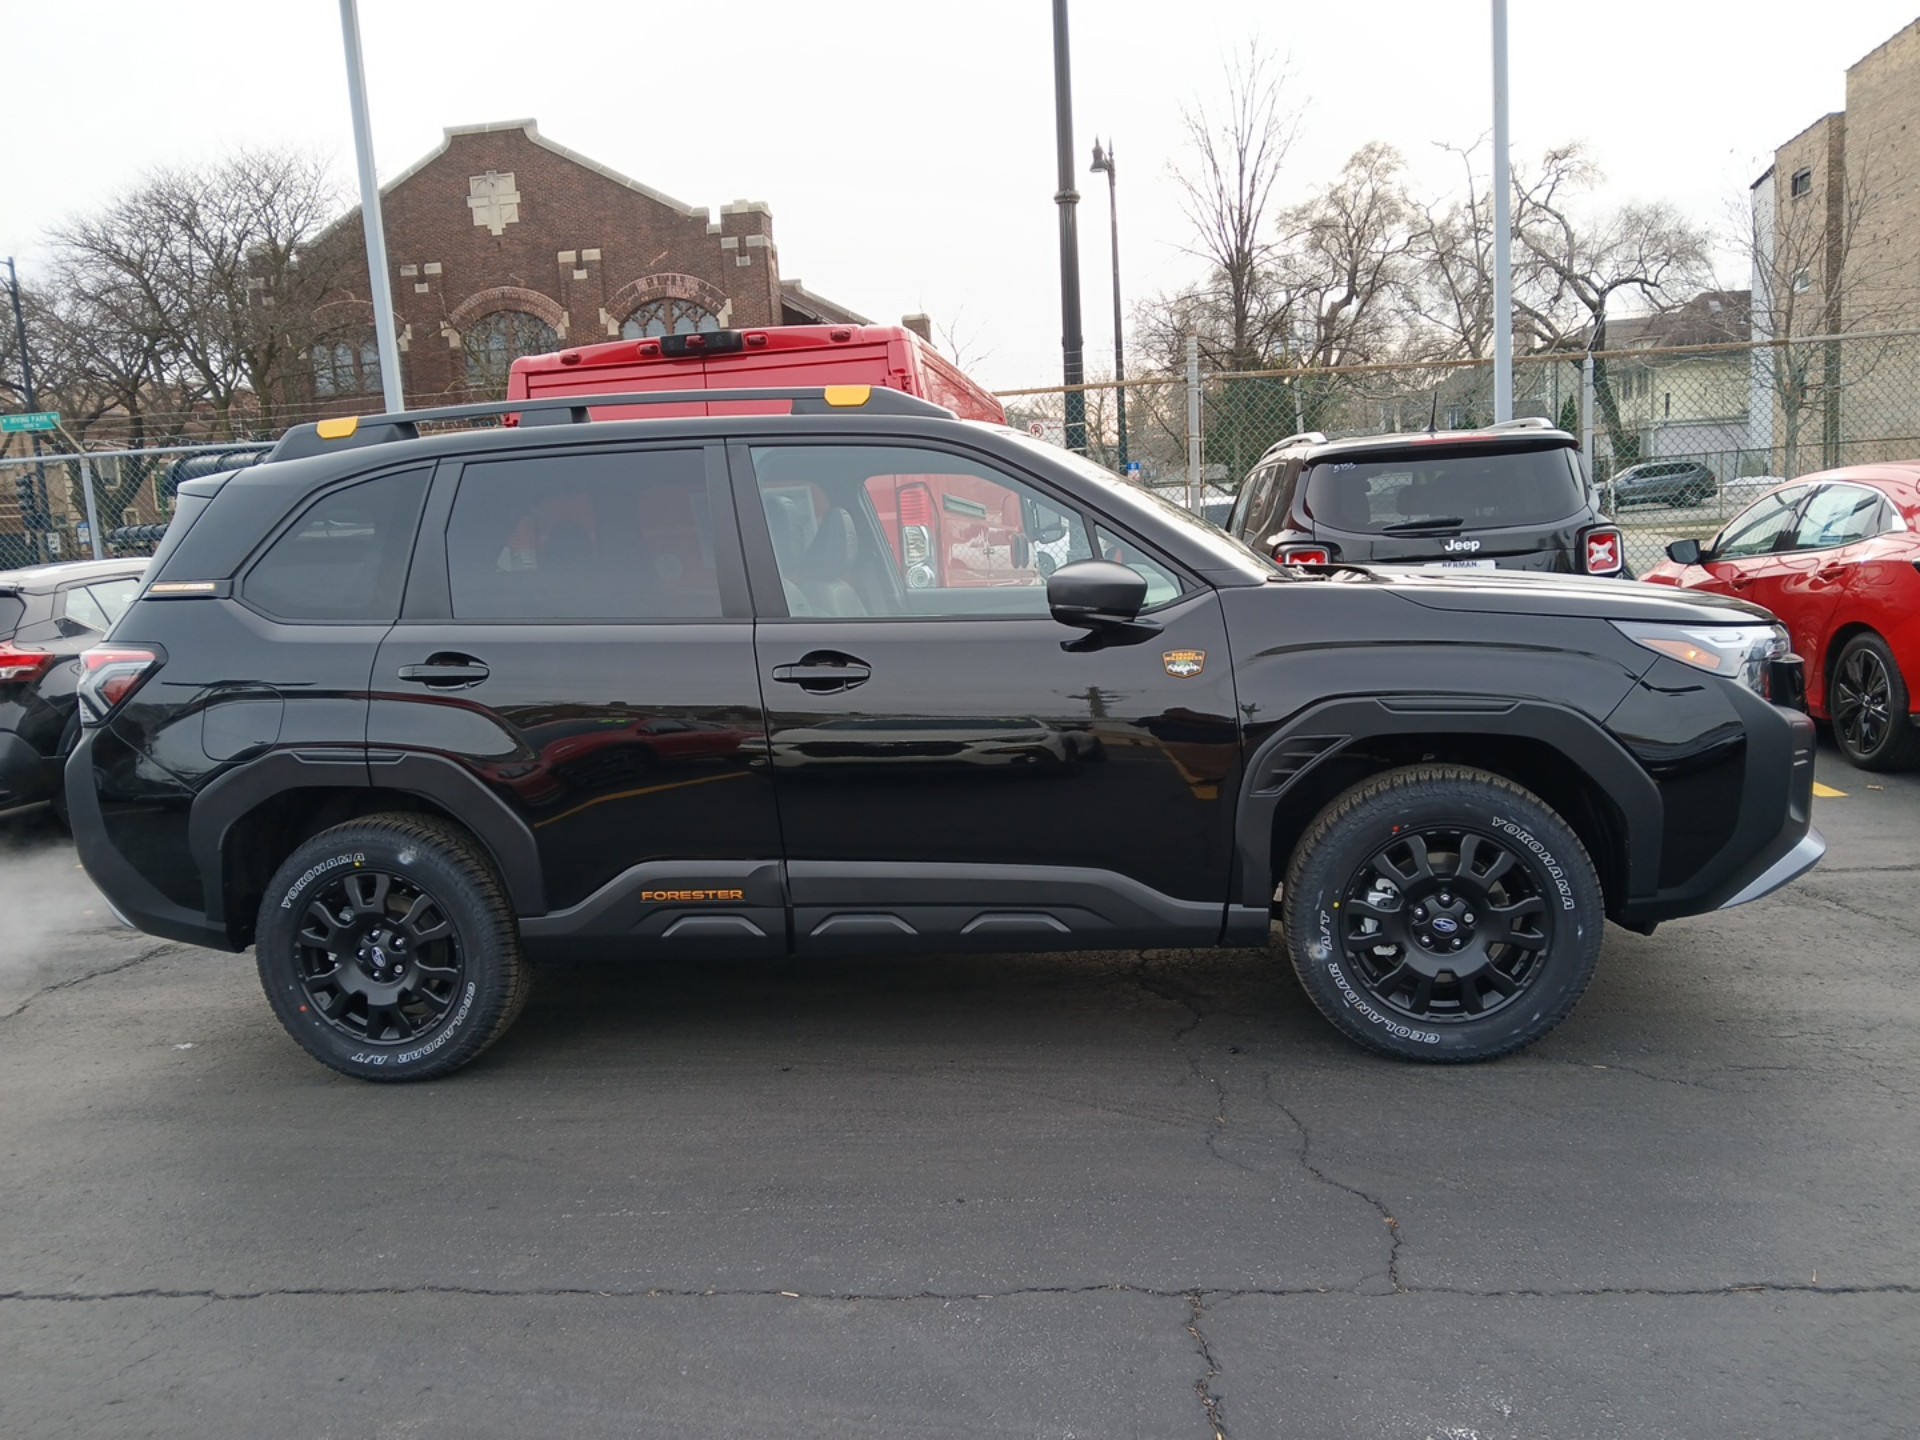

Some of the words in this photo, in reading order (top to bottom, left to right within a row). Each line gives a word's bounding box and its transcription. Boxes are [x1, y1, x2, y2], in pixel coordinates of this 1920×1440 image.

[1444, 539, 1480, 552] Jeep
[281, 853, 365, 908] YOKOHAMA
[1492, 816, 1575, 910] YOKOHAMA
[641, 890, 743, 901] FORESTER
[1320, 910, 1332, 950] A/T
[397, 981, 476, 1063] GEOLANDAR
[1328, 963, 1440, 1043] GEOLANDAR
[351, 1053, 388, 1064] A/T
